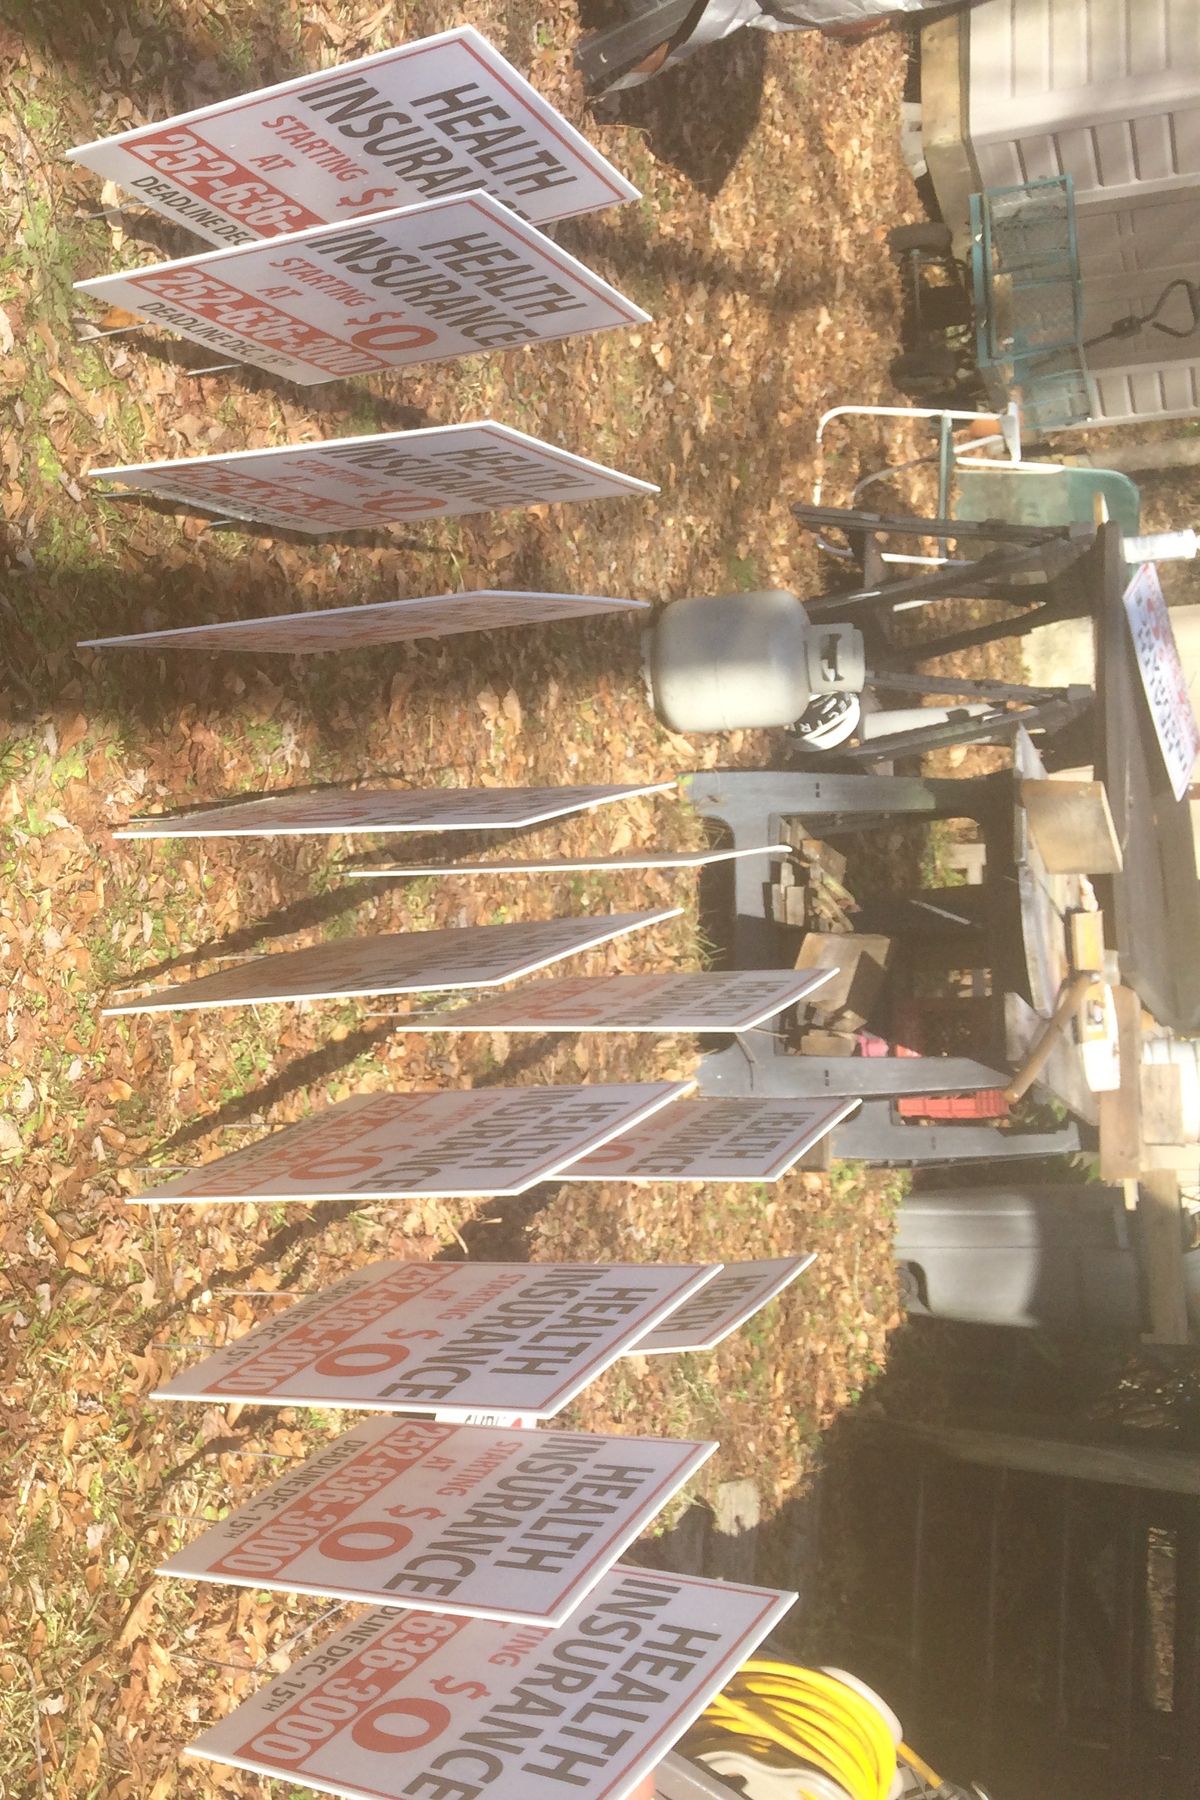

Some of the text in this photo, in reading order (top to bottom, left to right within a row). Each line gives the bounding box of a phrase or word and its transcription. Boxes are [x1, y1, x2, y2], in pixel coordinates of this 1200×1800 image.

[249, 154, 296, 172] AT
[261, 115, 369, 181] STARTING
[297, 78, 532, 220] INSURAN
[409, 83, 578, 195] HEALTH
[130, 134, 320, 237] 252-636-
[130, 175, 258, 247] DEADLINE DEC
[257, 286, 302, 299] AT
[269, 258, 377, 307] STARTING
[306, 230, 541, 347] INSURANCE
[418, 232, 588, 317] HEALTH
[132, 271, 383, 375] 252-636-3000
[138, 302, 233, 342] DEADLINE
[318, 444, 548, 507] INSURANCE
[431, 446, 596, 491] HEALTH
[347, 1089, 585, 1190] INSURANCE
[459, 1102, 630, 1169] HEALTH
[709, 1112, 815, 1158] HEALTH
[284, 1280, 369, 1319] DEADLINE
[422, 1289, 458, 1301] AT
[436, 1274, 527, 1320] STARTING
[651, 1274, 769, 1334] HEALTH
[219, 1264, 455, 1394] 252-636-3000
[377, 1268, 611, 1399] INSURANCE
[488, 1287, 659, 1375] HEALTH
[283, 1440, 368, 1486] DEADLINE
[421, 1456, 457, 1472] AT
[437, 1441, 523, 1497] STARTING
[219, 1424, 452, 1573] 252-636-3000
[248, 1487, 303, 1512] DEC.
[382, 1437, 608, 1596] INSURANCE
[493, 1464, 656, 1573] HEALTH
[295, 1645, 350, 1677] DEC.
[402, 1579, 682, 1800] INSURANCE
[519, 1624, 723, 1786] HEALTH
